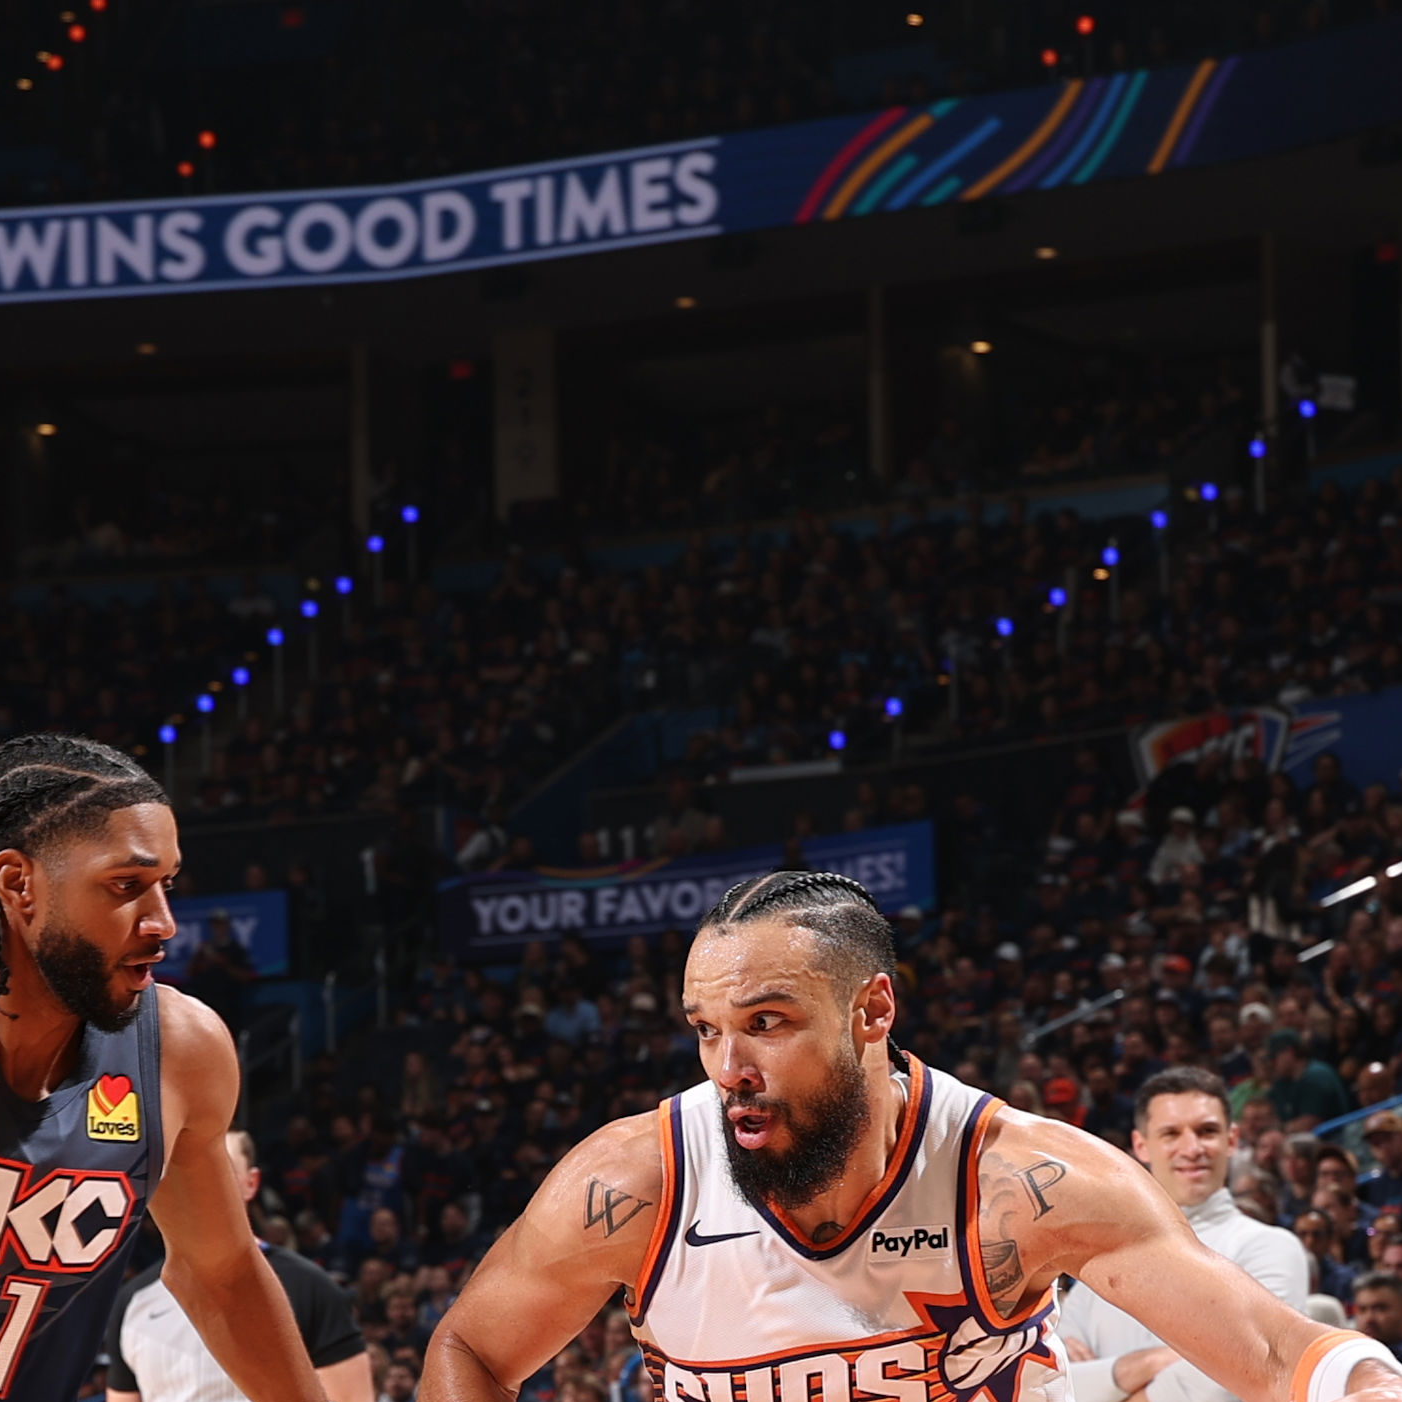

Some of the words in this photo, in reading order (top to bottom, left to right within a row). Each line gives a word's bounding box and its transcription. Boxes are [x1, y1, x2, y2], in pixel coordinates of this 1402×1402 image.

[223, 191, 477, 278] GOOD
[488, 151, 719, 252] TIMES
[470, 888, 586, 938] YOUR
[89, 1115, 136, 1137] Love's
[871, 1227, 949, 1257] PayPal
